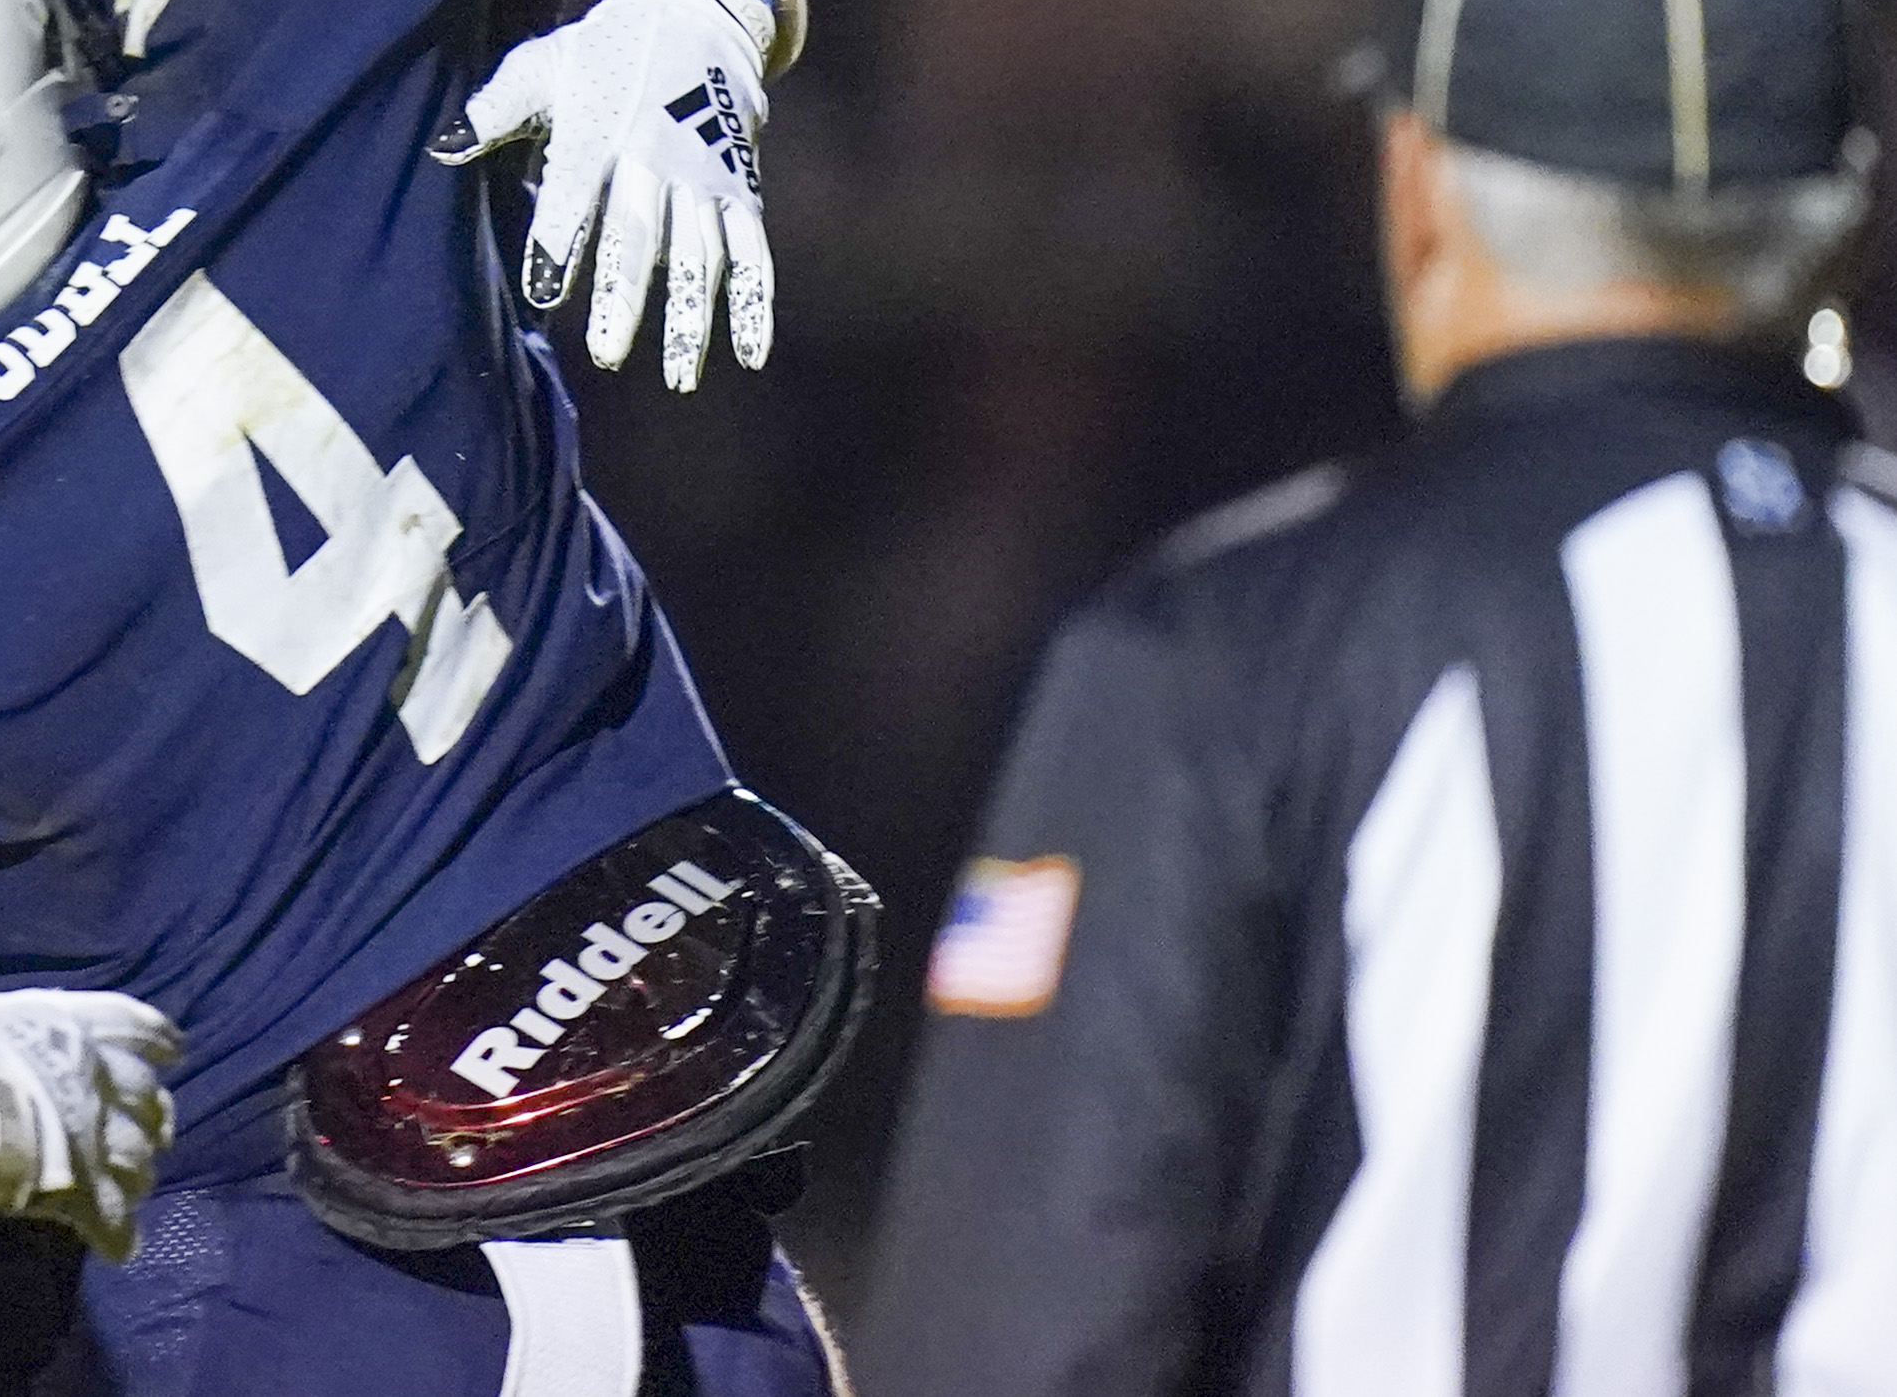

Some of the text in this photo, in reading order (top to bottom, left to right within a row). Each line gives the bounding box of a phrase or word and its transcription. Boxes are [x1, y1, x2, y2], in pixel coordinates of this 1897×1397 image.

[707, 66, 761, 195] adidas
[118, 268, 514, 766] 4
[449, 859, 741, 1100] Riddell
